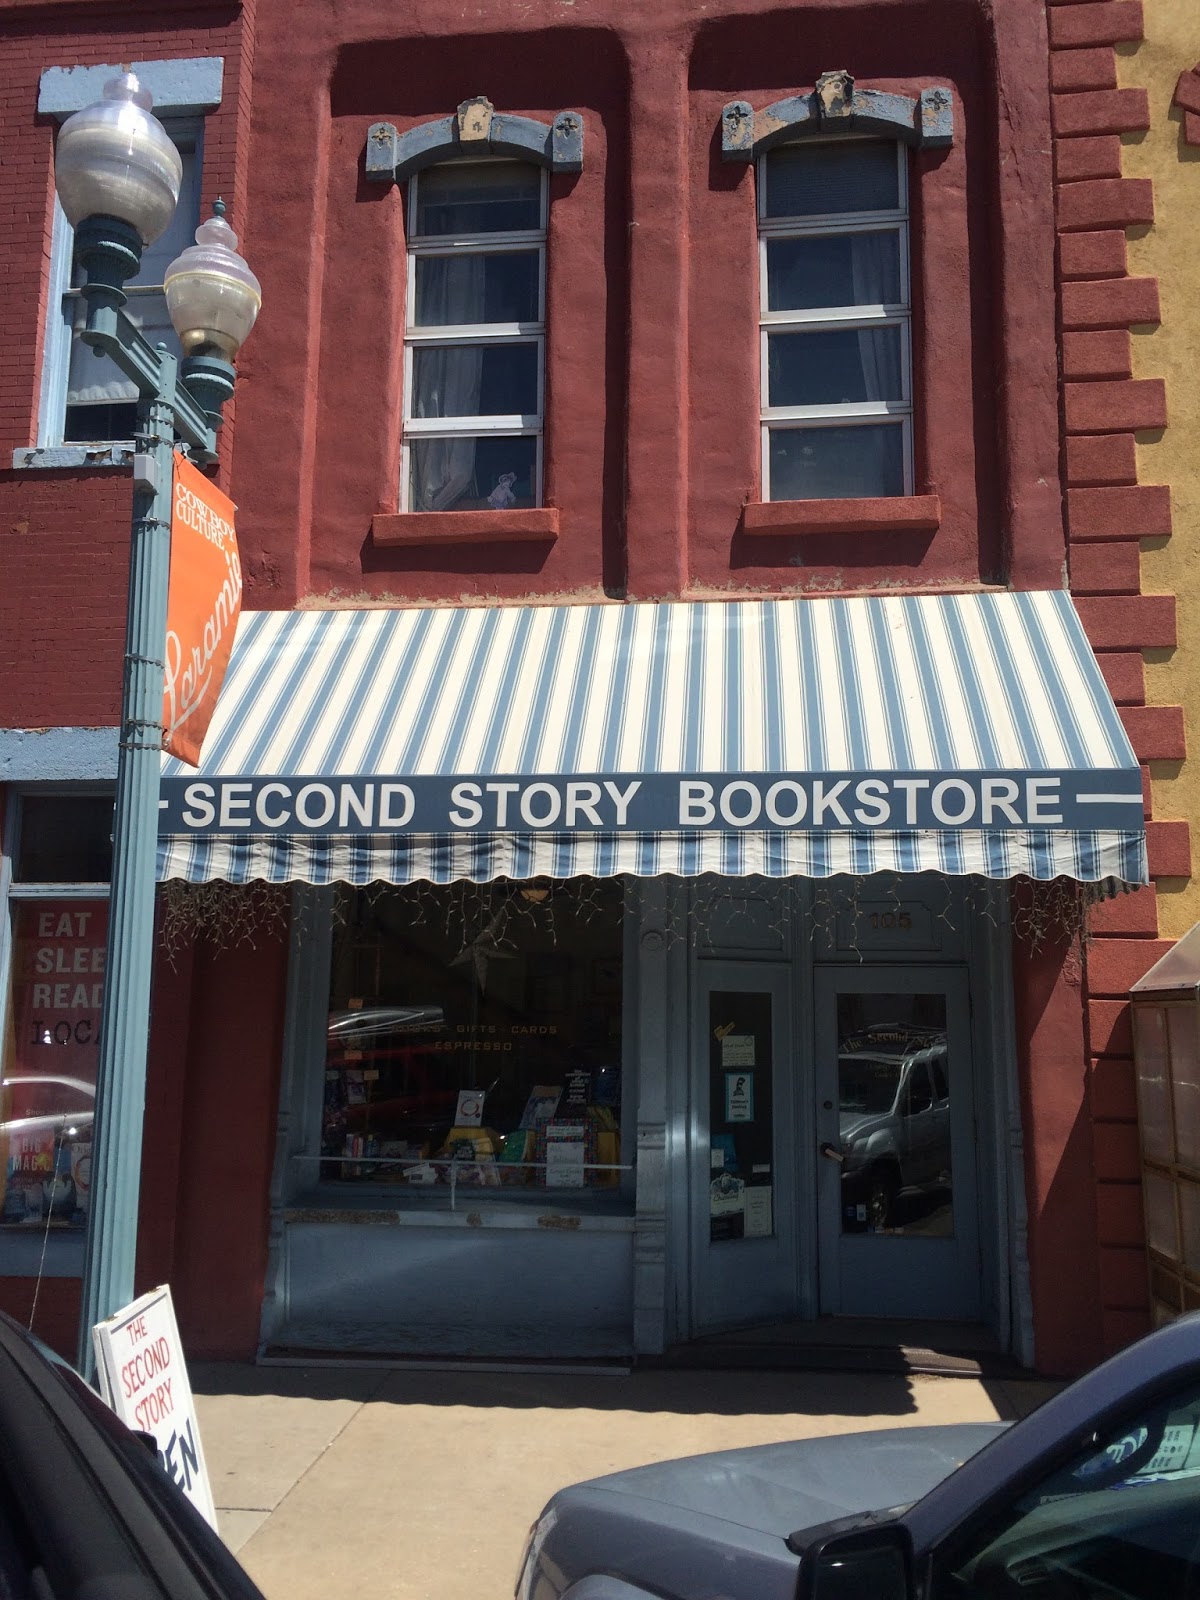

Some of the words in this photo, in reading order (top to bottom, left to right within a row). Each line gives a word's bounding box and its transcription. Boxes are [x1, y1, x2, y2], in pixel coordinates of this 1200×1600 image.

[175, 482, 235, 543] COWBOY
[175, 498, 225, 551] CULTURE
[163, 549, 243, 735] Laramie
[181, 782, 416, 829] SECOND
[448, 781, 641, 828] STORY
[678, 777, 1064, 828] BOOKSTORE
[38, 911, 92, 937] EAT
[870, 911, 912, 929] 105
[35, 947, 107, 973] SLEE
[434, 1041, 512, 1051] ESPRESSO
[456, 1024, 496, 1034] GIFTS
[511, 1025, 558, 1035] CARDS
[126, 1315, 148, 1347] THE
[121, 1336, 171, 1399] SECOND
[134, 1377, 175, 1432] STORY
[160, 1417, 199, 1492] EN
